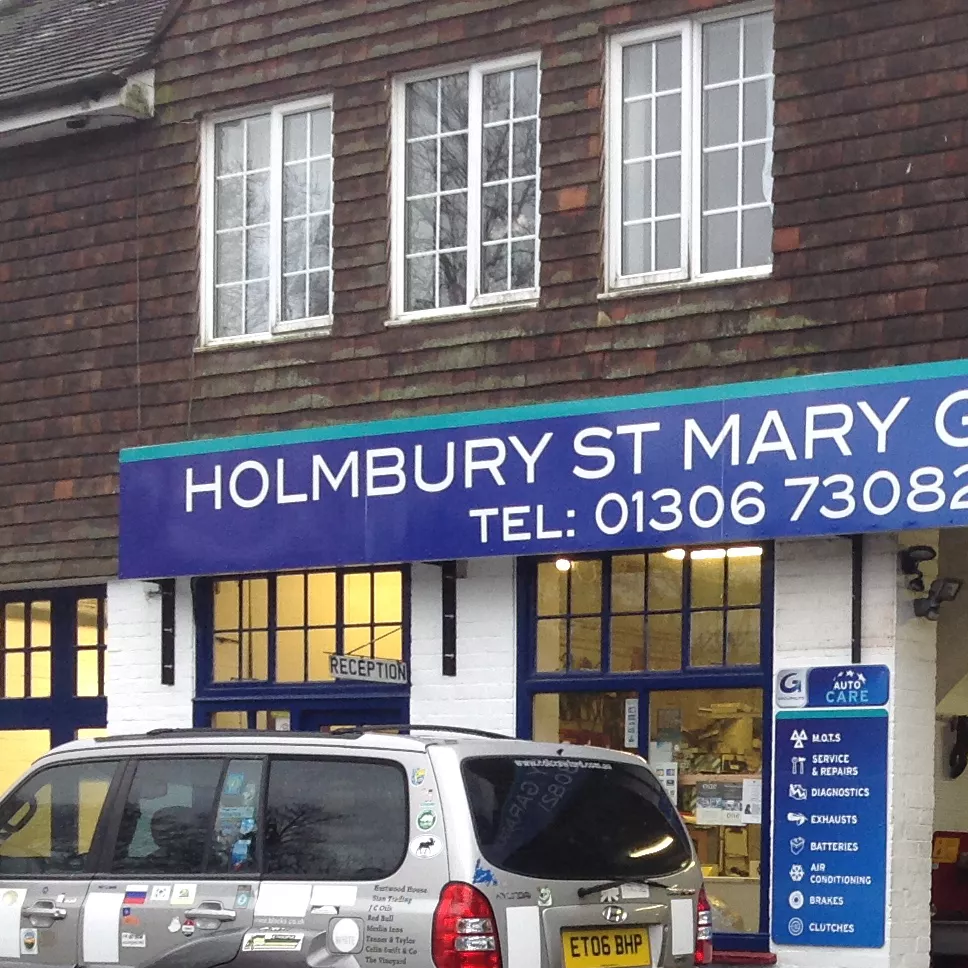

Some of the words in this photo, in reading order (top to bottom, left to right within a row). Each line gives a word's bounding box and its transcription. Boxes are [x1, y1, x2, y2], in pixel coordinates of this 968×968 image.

[185, 432, 553, 512] HOLMBURY
[572, 421, 660, 480] ST
[684, 397, 910, 470] MARY
[469, 505, 576, 543] TEL:
[595, 480, 766, 535] 01306
[330, 656, 407, 681] RECEPTION
[833, 680, 861, 690] AUTO
[826, 690, 869, 703] CARE
[812, 754, 850, 763] SERVICE
[811, 767, 818, 776] &
[820, 767, 858, 776] REPAIRS
[811, 788, 870, 797] DIAGNOSTICS
[810, 815, 858, 824] EXHAUSTS
[810, 842, 859, 851] BATTERIES
[810, 863, 826, 871] AIR
[810, 875, 872, 885] CONDITIONING
[809, 896, 844, 905] BRAKES
[809, 923, 855, 933] CLUTCHES
[570, 935, 610, 958] ET06
[614, 934, 643, 956] BHP
